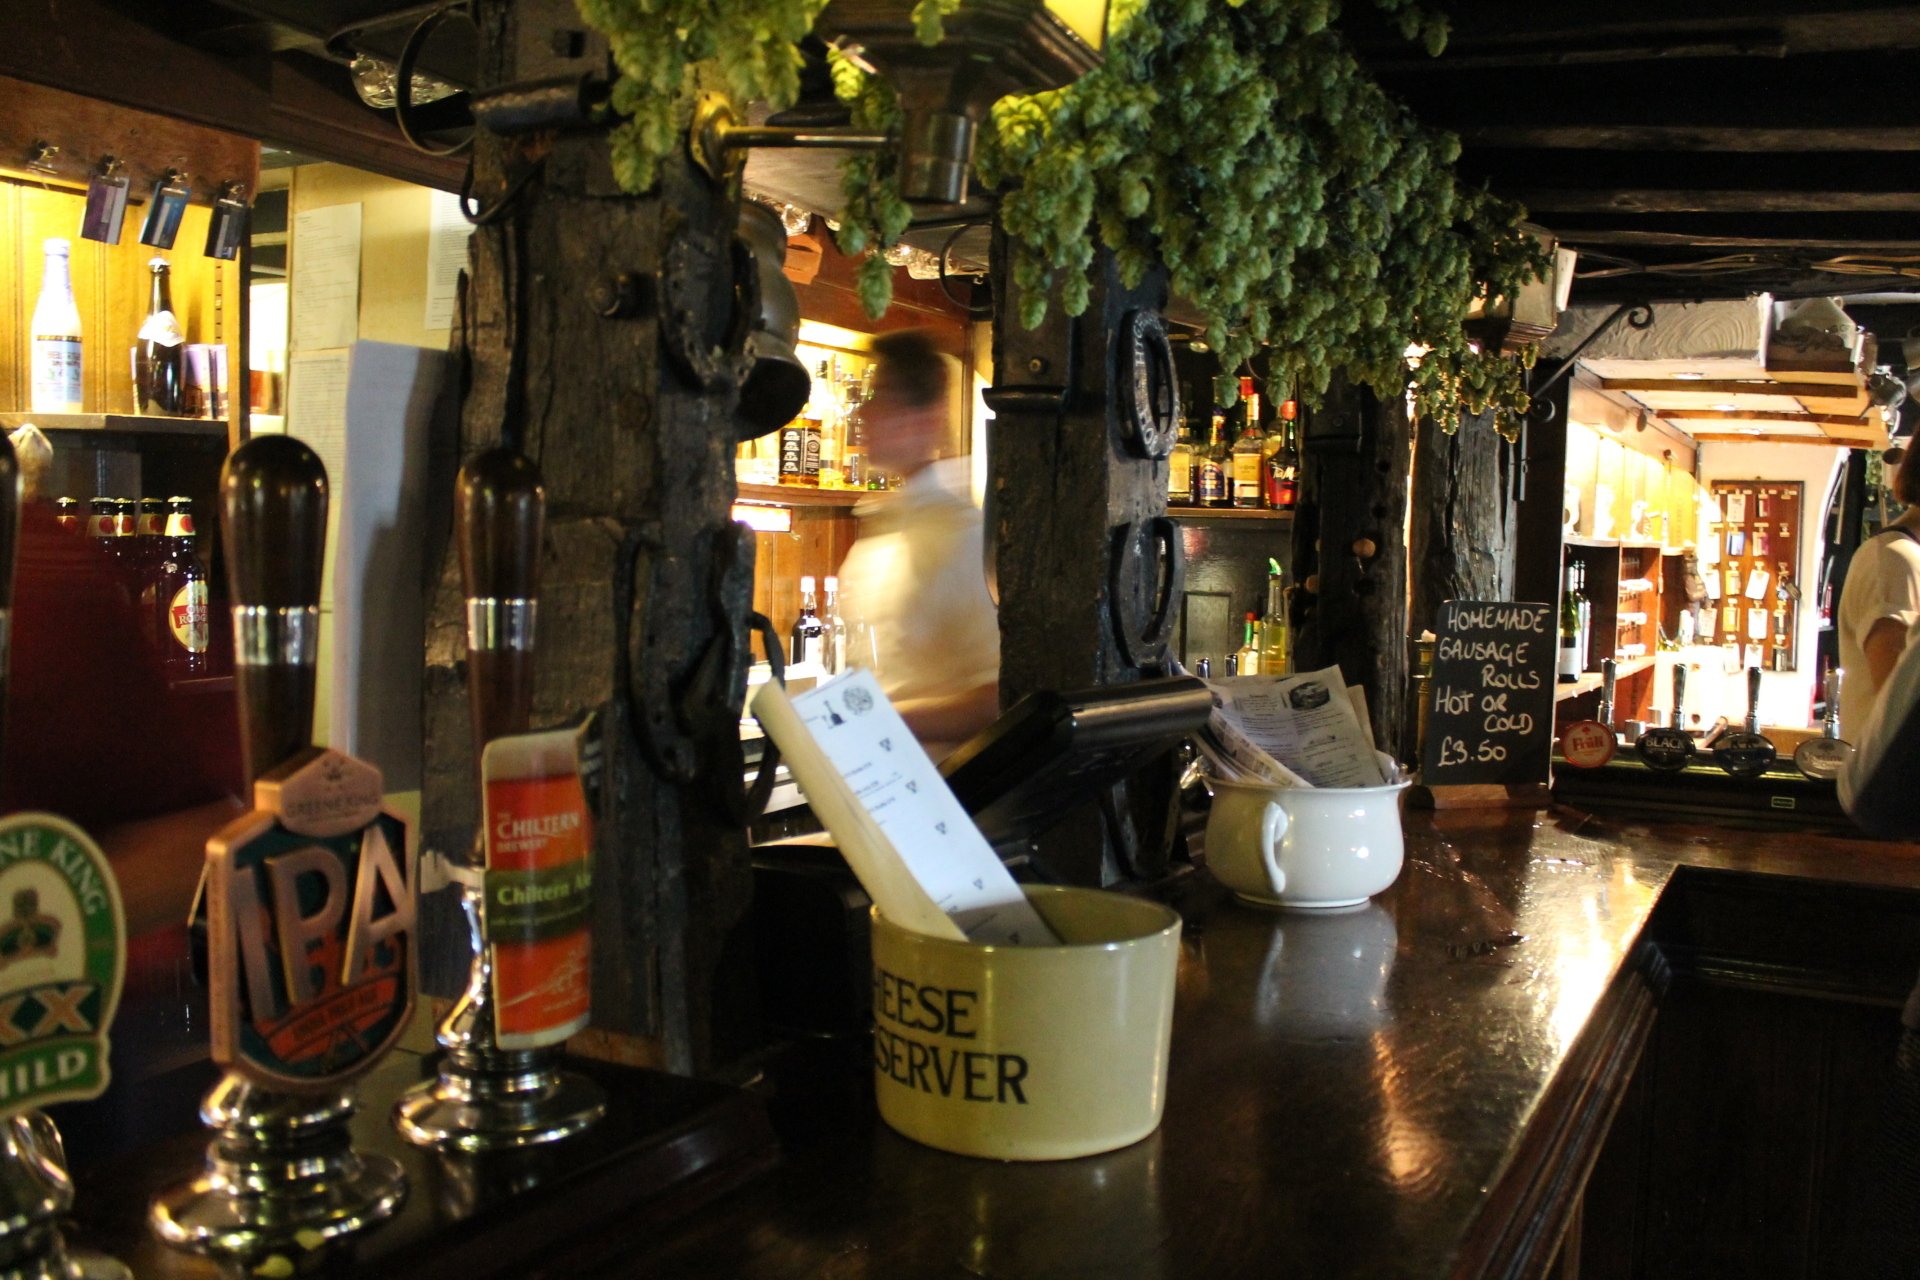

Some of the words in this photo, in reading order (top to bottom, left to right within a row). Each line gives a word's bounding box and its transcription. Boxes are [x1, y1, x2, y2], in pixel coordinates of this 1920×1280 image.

[1448, 606, 1550, 632] HOMEMADE
[1482, 663, 1540, 690] ROLLS
[1435, 684, 1474, 716] HOT
[1481, 693, 1507, 713] OR
[1484, 713, 1533, 735] COLD
[1438, 736, 1507, 767] £3.50
[496, 811, 580, 840] CHILTERN
[49, 838, 108, 915] KING
[496, 883, 570, 905] Chiltern
[229, 824, 414, 1023] IPA
[0, 1049, 87, 1100] ILD
